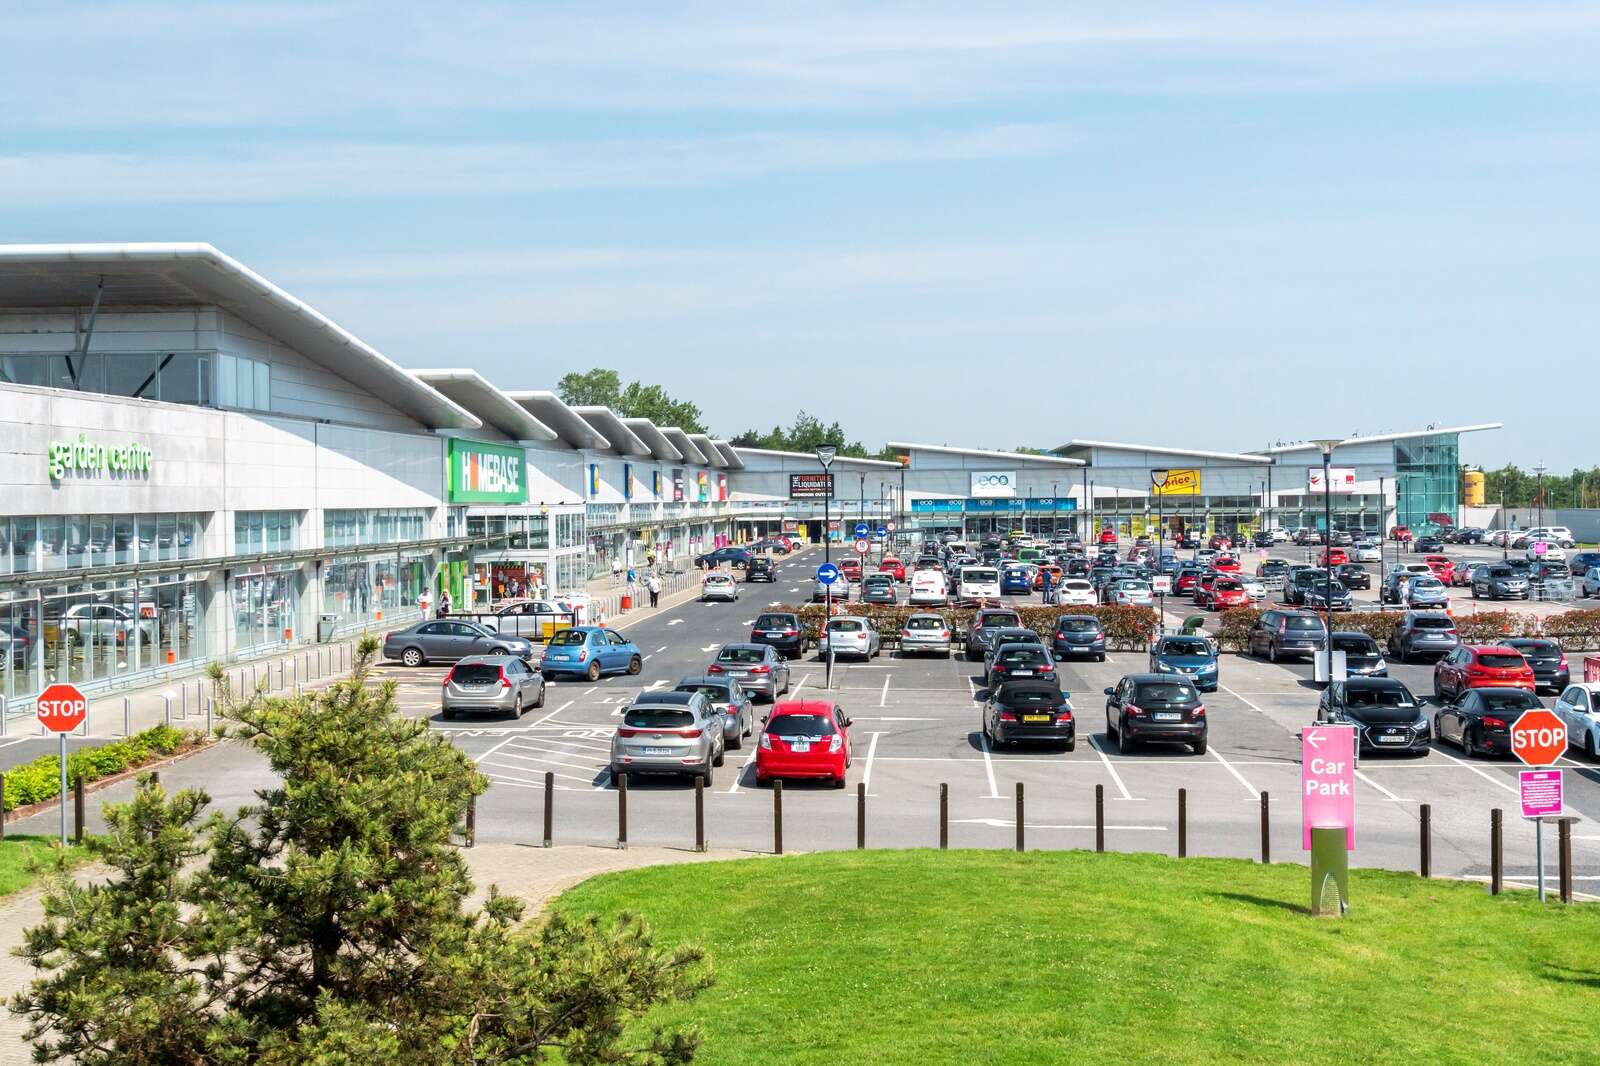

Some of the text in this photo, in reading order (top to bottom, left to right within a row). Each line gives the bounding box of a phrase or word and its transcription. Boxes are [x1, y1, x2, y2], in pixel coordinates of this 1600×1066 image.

[49, 433, 152, 479] garden centre
[462, 450, 519, 493] HOMEBASE
[39, 700, 84, 717] STOP
[1514, 728, 1564, 748] STOP
[1311, 758, 1345, 775] Car
[1306, 780, 1350, 796] Park
